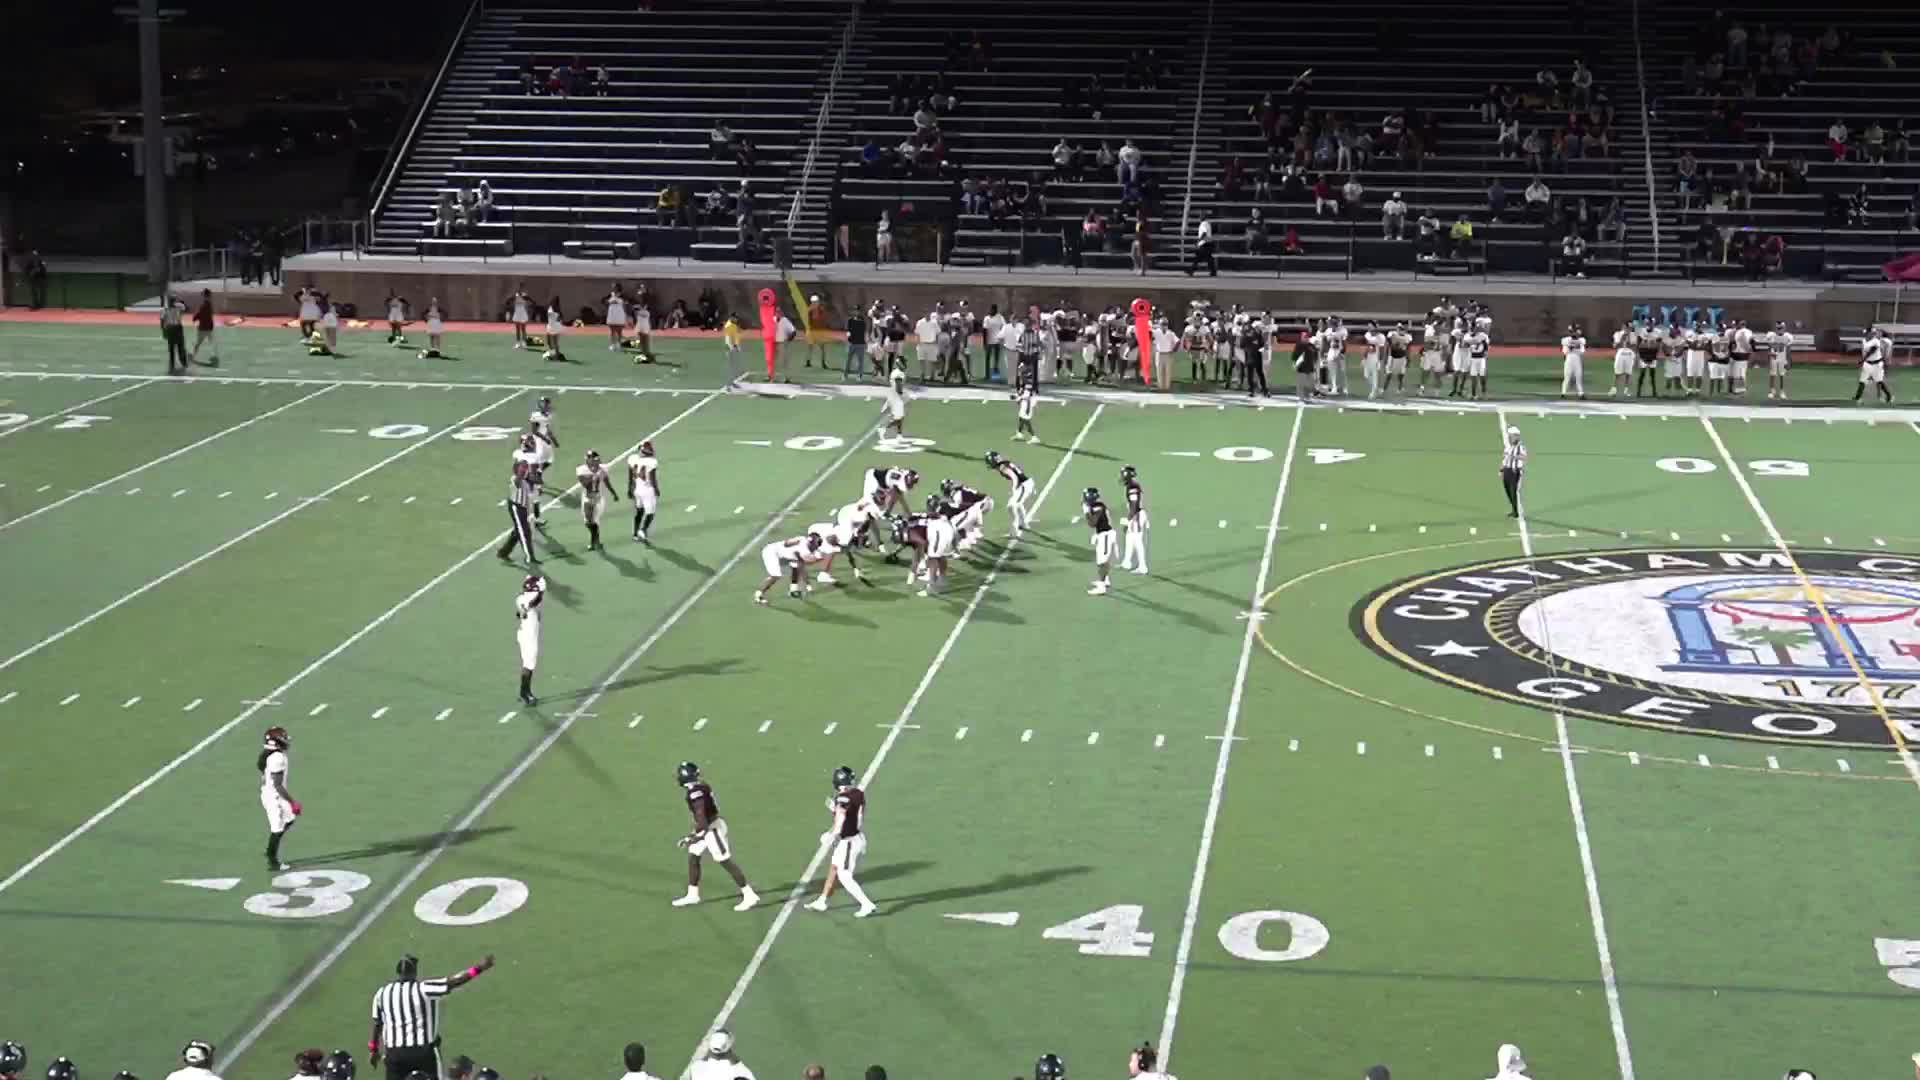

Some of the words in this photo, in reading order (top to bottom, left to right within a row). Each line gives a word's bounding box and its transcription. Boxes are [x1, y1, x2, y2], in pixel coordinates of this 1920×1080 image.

[1394, 553, 1793, 620] CHATHAM
[243, 869, 530, 926] 30
[1042, 904, 1330, 961] 40
